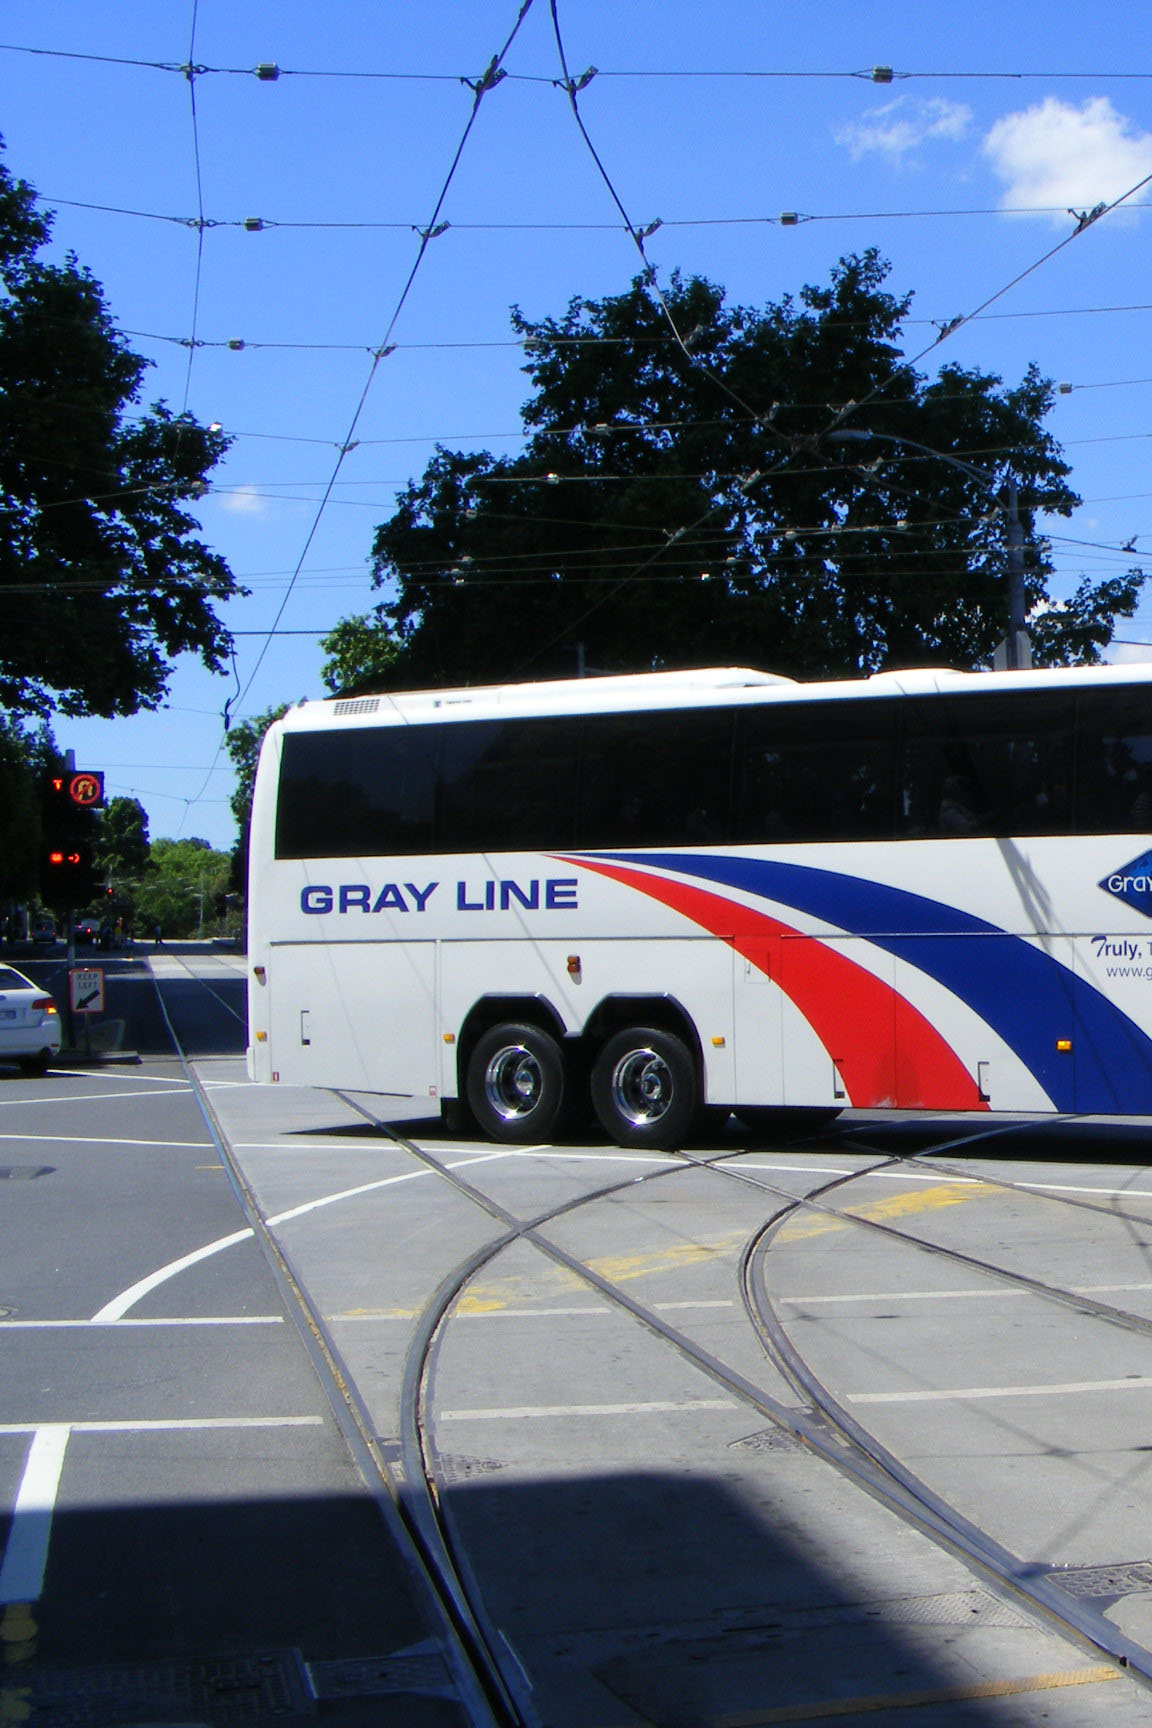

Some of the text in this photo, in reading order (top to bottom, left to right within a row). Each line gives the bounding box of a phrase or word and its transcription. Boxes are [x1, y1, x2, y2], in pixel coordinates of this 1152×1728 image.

[300, 878, 578, 915] GRAY LINE
[1091, 935, 1142, 960] Truly,
[78, 981, 97, 989] LEFT
